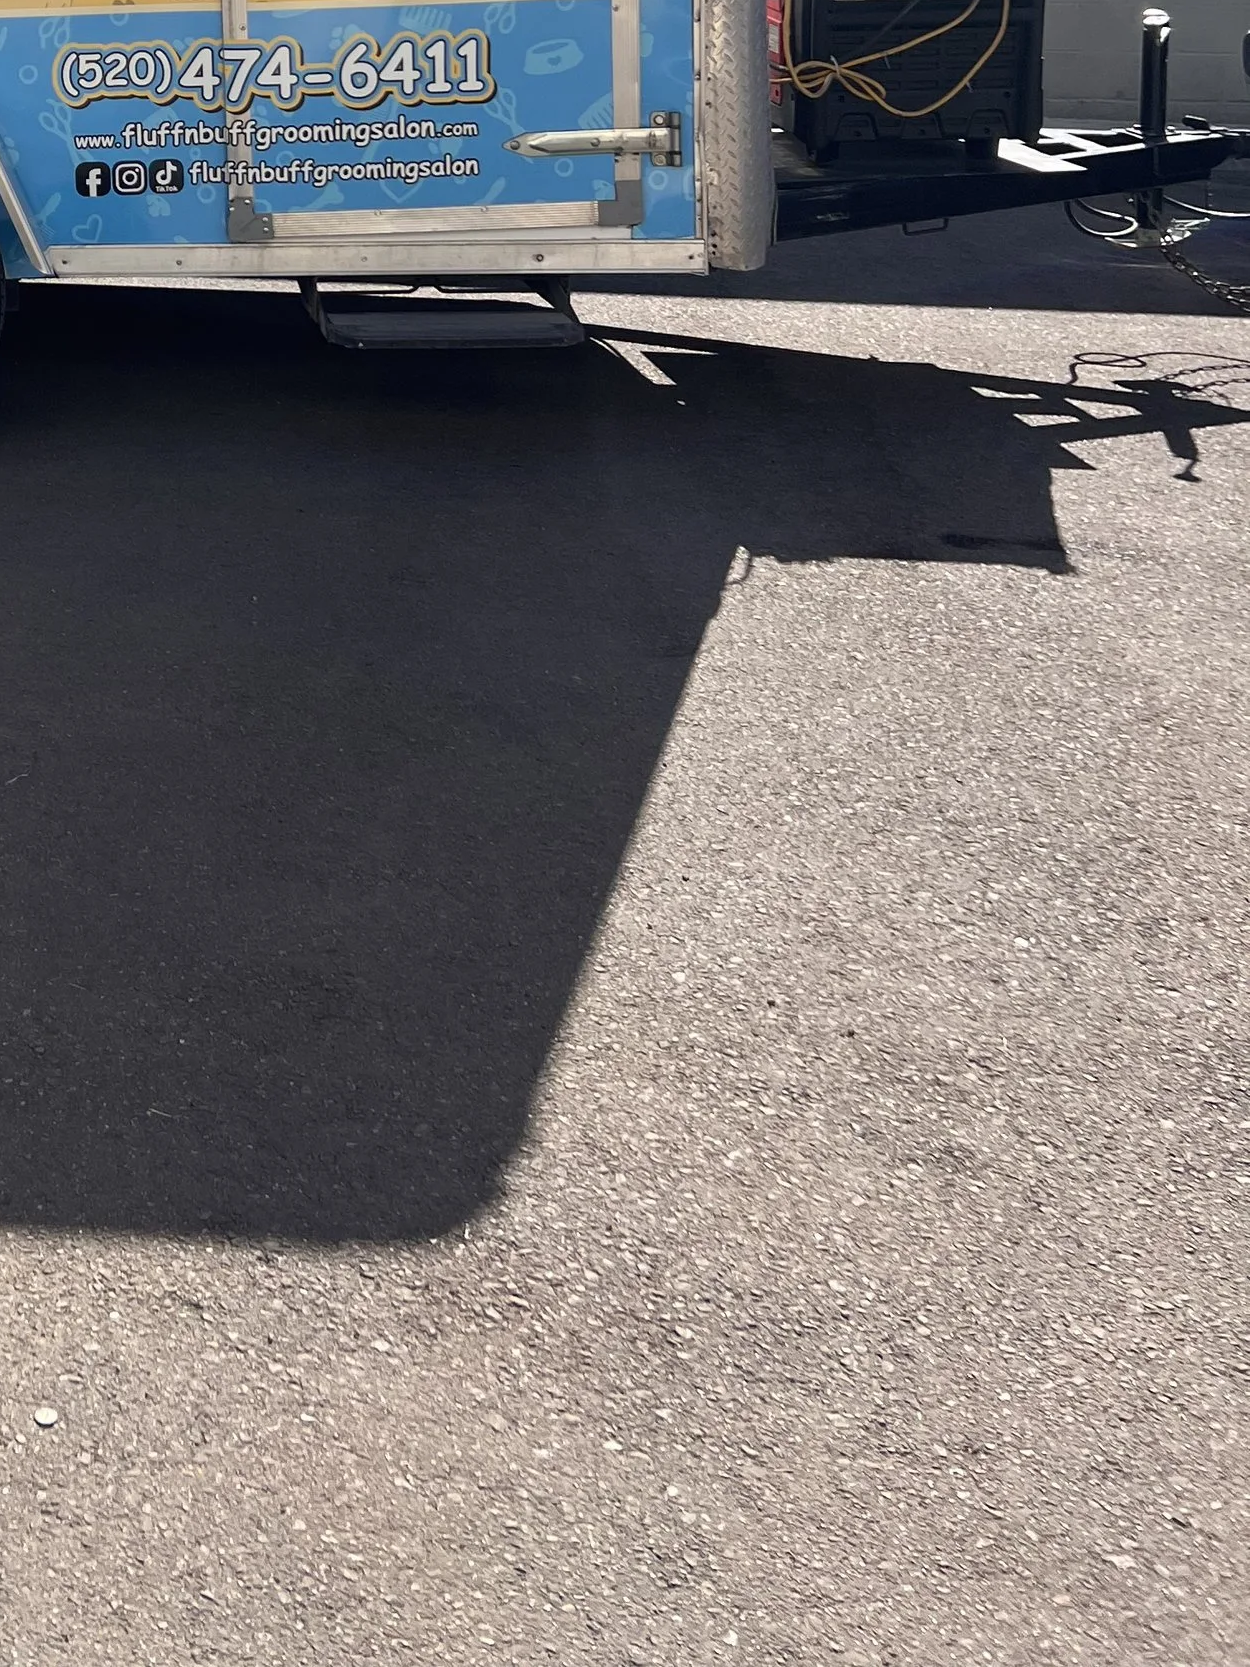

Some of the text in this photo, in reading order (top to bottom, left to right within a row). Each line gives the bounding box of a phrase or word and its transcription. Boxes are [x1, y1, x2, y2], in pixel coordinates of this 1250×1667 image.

[61, 39, 484, 102] (520) 474-6411
[75, 115, 478, 150] www.fluffnbuffgroomingsalon.com
[188, 155, 478, 187] fluffnbuffgroomingsalon
[155, 185, 179, 193] TikTok
